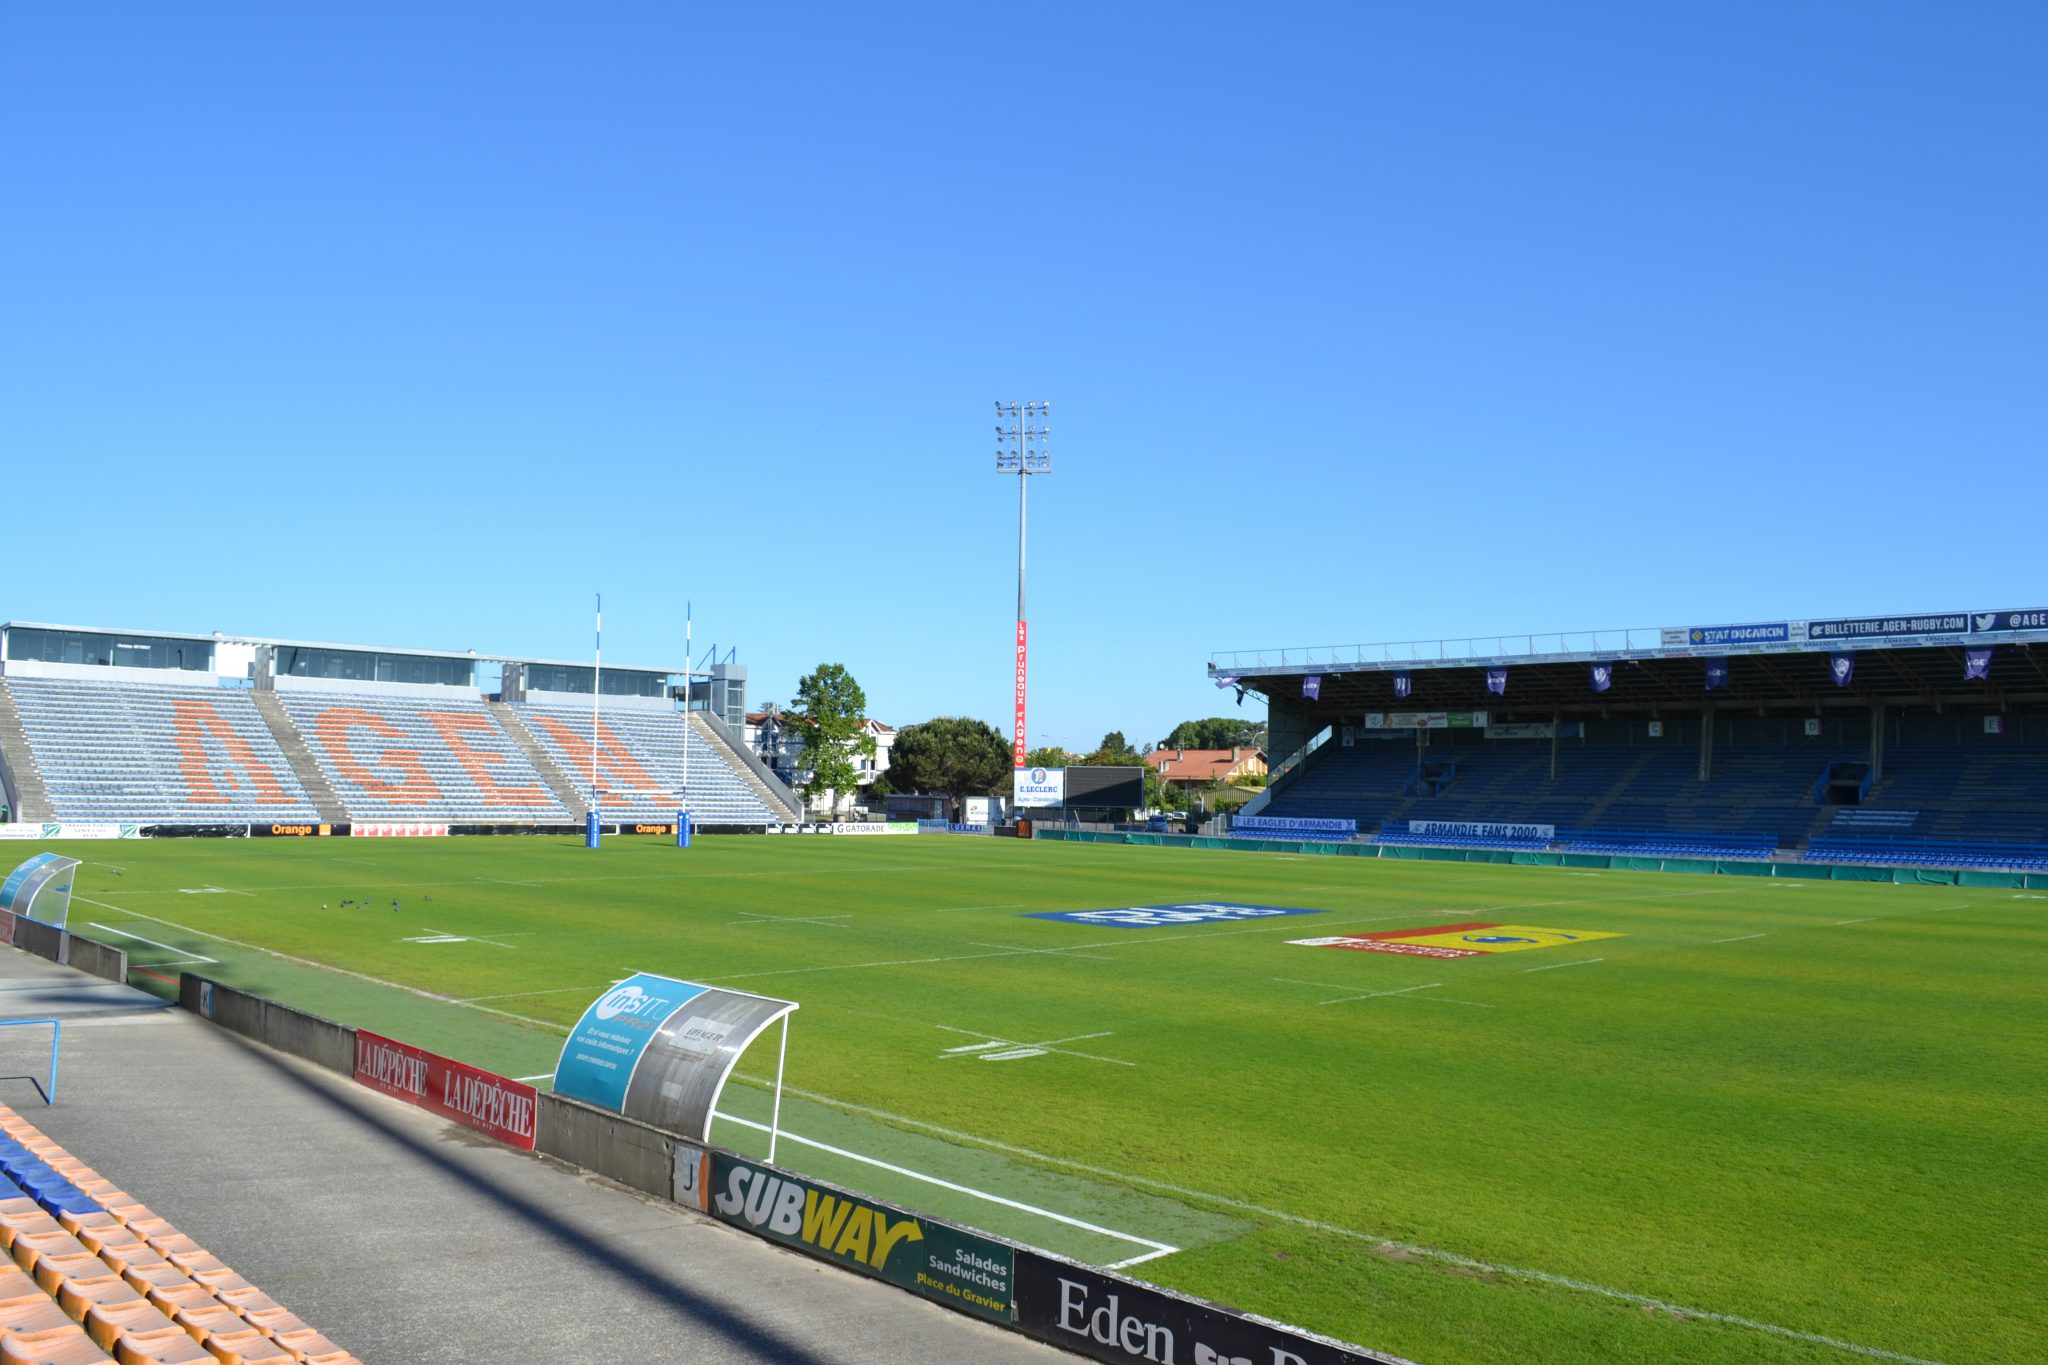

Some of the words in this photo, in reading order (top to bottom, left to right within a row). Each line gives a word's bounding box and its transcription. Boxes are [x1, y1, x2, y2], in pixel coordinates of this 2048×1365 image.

[1704, 629, 1730, 642] STAT
[1731, 627, 1784, 640] DUGARCIN
[1824, 616, 1965, 636] BILLETTERIE.AGEN-RUGBY.COM
[1017, 645, 1026, 705] pruneaux
[271, 824, 312, 836] Orange
[635, 824, 667, 835] Orange
[845, 825, 885, 833] GATORADE
[1242, 817, 1256, 826] LES
[1258, 818, 1288, 828] EAGLES
[1289, 819, 1343, 830] D'ARMANDIE
[1424, 822, 1478, 837] ARMANDIE
[1481, 825, 1508, 838] FANS
[1511, 826, 1538, 838] 2000
[203, 991, 209, 1009] K
[683, 1163, 694, 1191] J
[714, 1165, 925, 1272] SUBWAY
[955, 1248, 1008, 1276] Salades
[929, 1255, 1007, 1292] Sandwiches
[916, 1272, 944, 1290] Place
[946, 1283, 961, 1297] du
[962, 1288, 1006, 1312] Gravier
[1056, 1277, 1175, 1365] Eden
